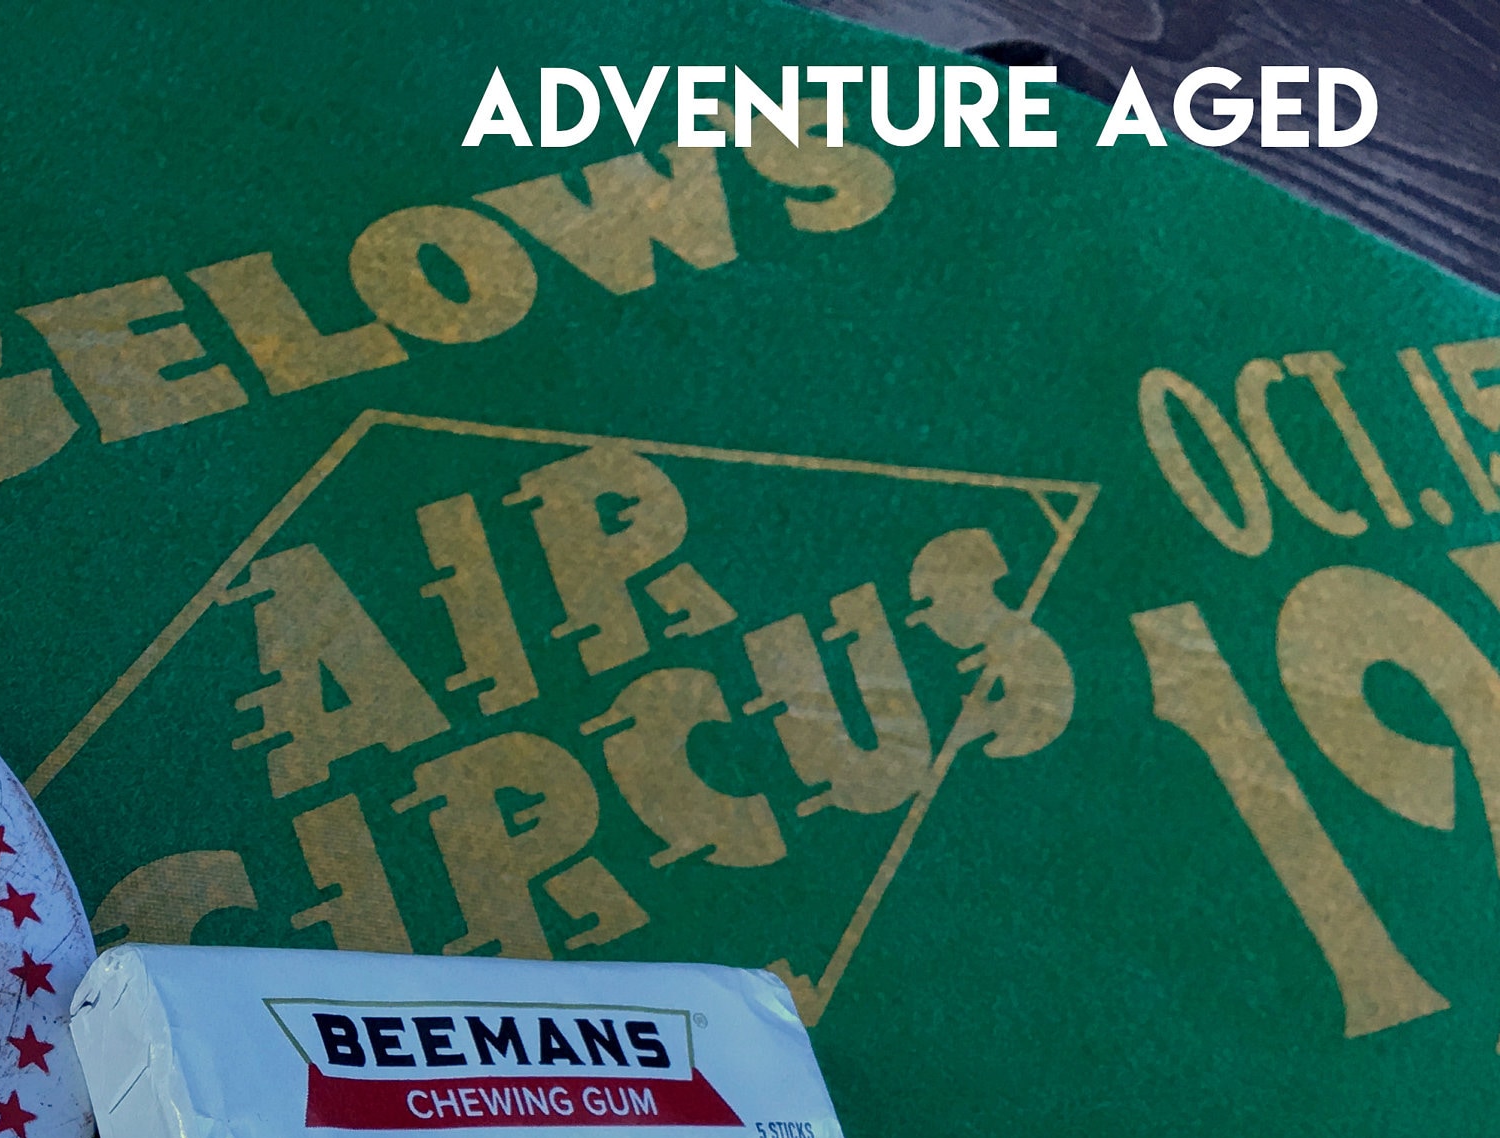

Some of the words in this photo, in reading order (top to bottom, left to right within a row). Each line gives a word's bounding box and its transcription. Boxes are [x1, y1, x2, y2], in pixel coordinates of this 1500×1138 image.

[218, 444, 738, 797] AIR
[314, 1013, 670, 1068] BEEMANS
[407, 1087, 575, 1119] CHEWING
[585, 1087, 658, 1117] GUM
